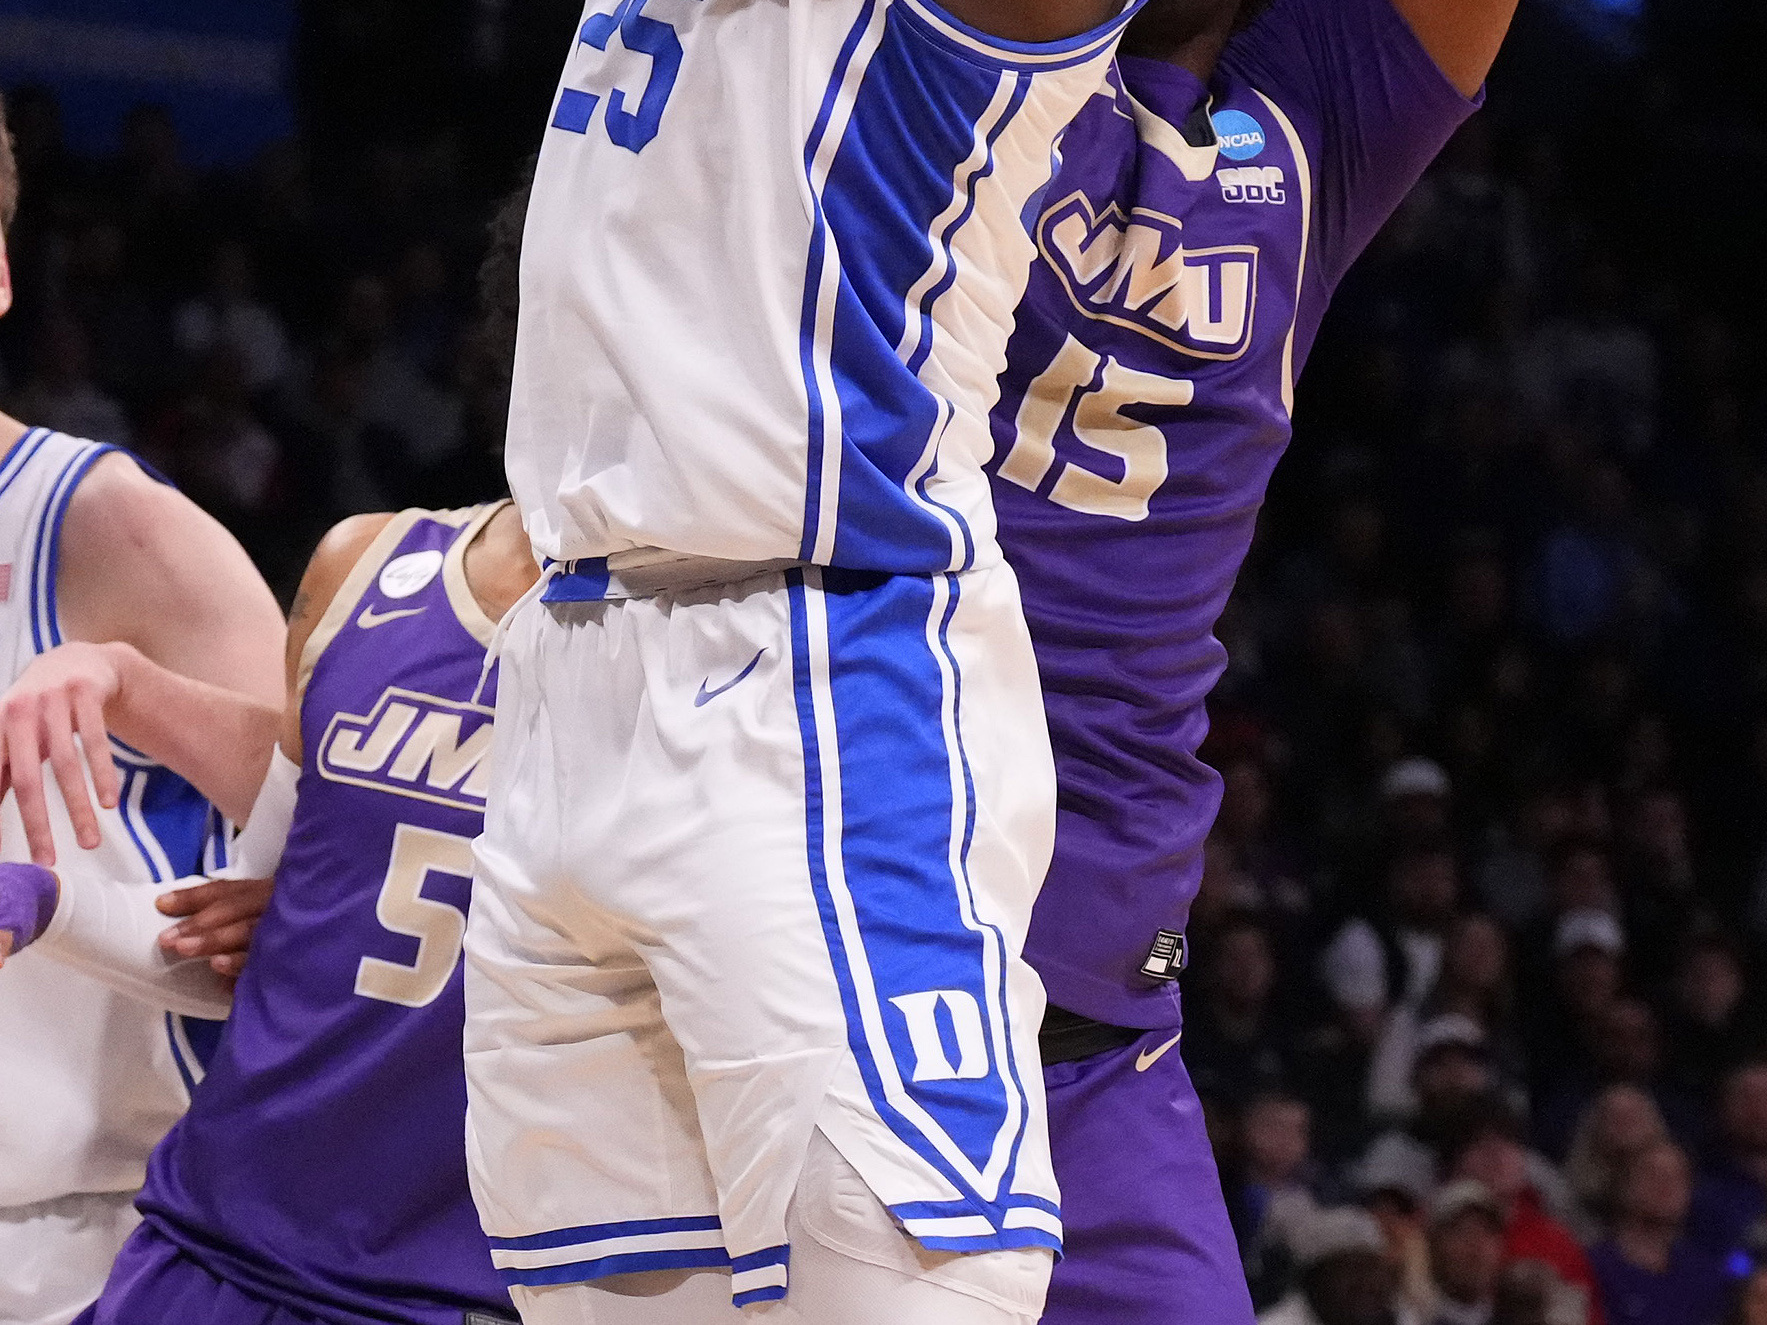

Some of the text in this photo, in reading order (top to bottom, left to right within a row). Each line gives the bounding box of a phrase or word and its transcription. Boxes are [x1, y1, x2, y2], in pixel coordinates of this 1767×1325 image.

[1215, 166, 1287, 205] SBC
[1217, 131, 1263, 149] NCAA
[1048, 208, 1253, 346] JMU
[996, 332, 1194, 522] 15
[327, 700, 499, 798] JM
[353, 822, 475, 1009] 5
[887, 989, 991, 1083] D
